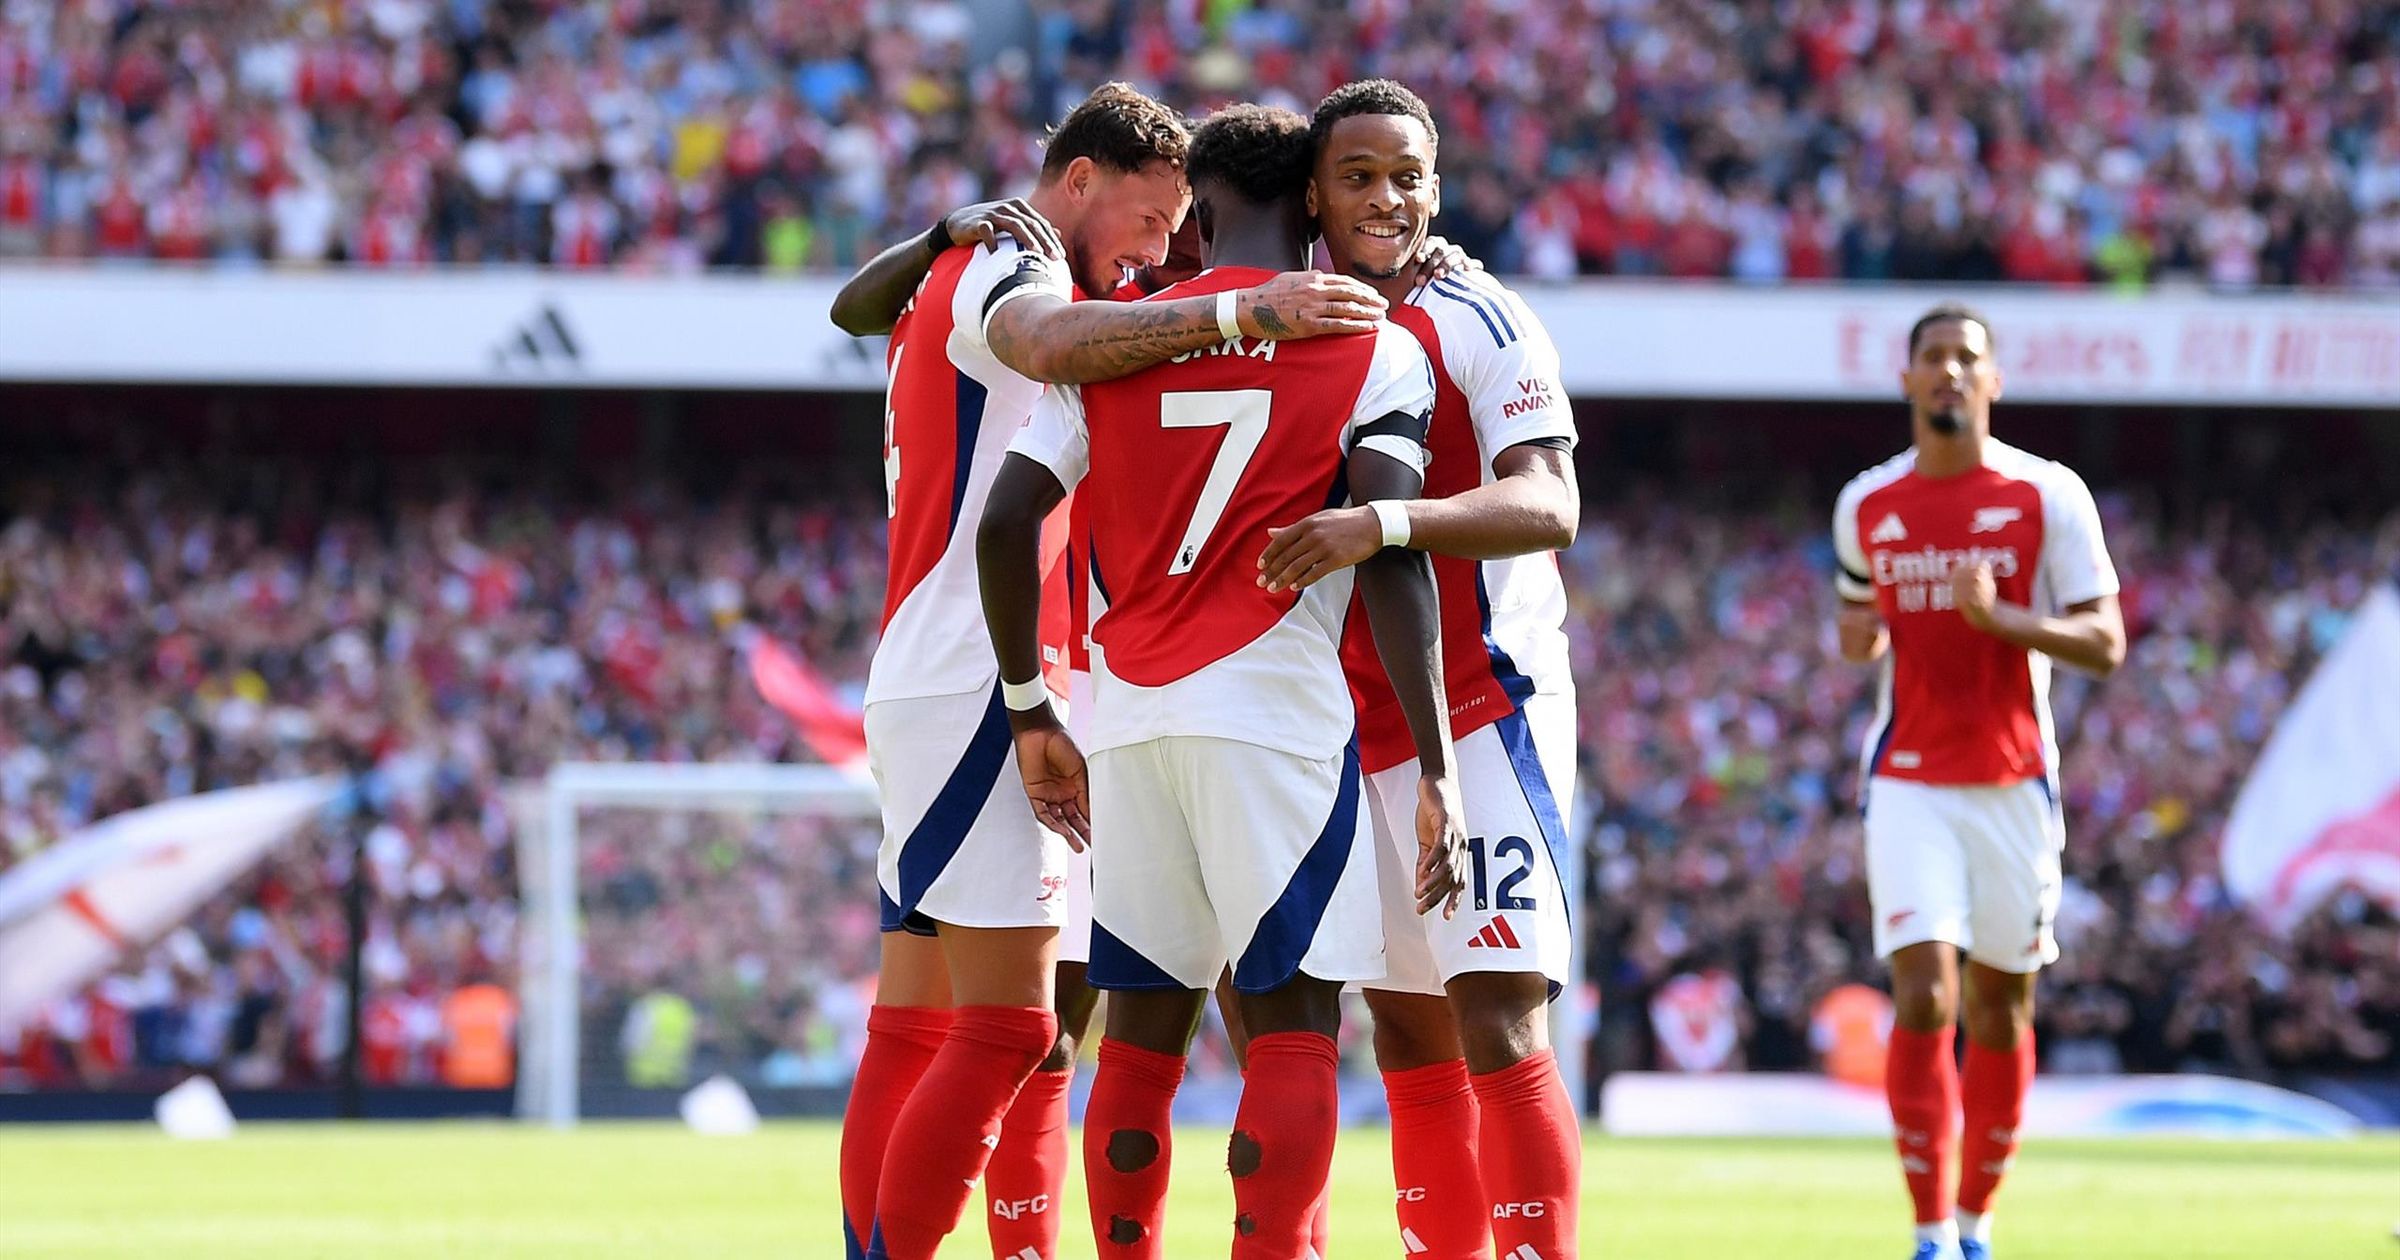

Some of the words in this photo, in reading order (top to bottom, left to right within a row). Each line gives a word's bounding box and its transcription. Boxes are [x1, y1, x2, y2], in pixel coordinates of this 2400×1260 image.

[1838, 316, 2150, 376] Eates
[1161, 389, 1272, 575] 7
[1467, 836, 1536, 911] 12
[994, 1194, 1049, 1220] AFC
[1396, 1187, 1426, 1204] FC
[1493, 1202, 1545, 1219] AFC
